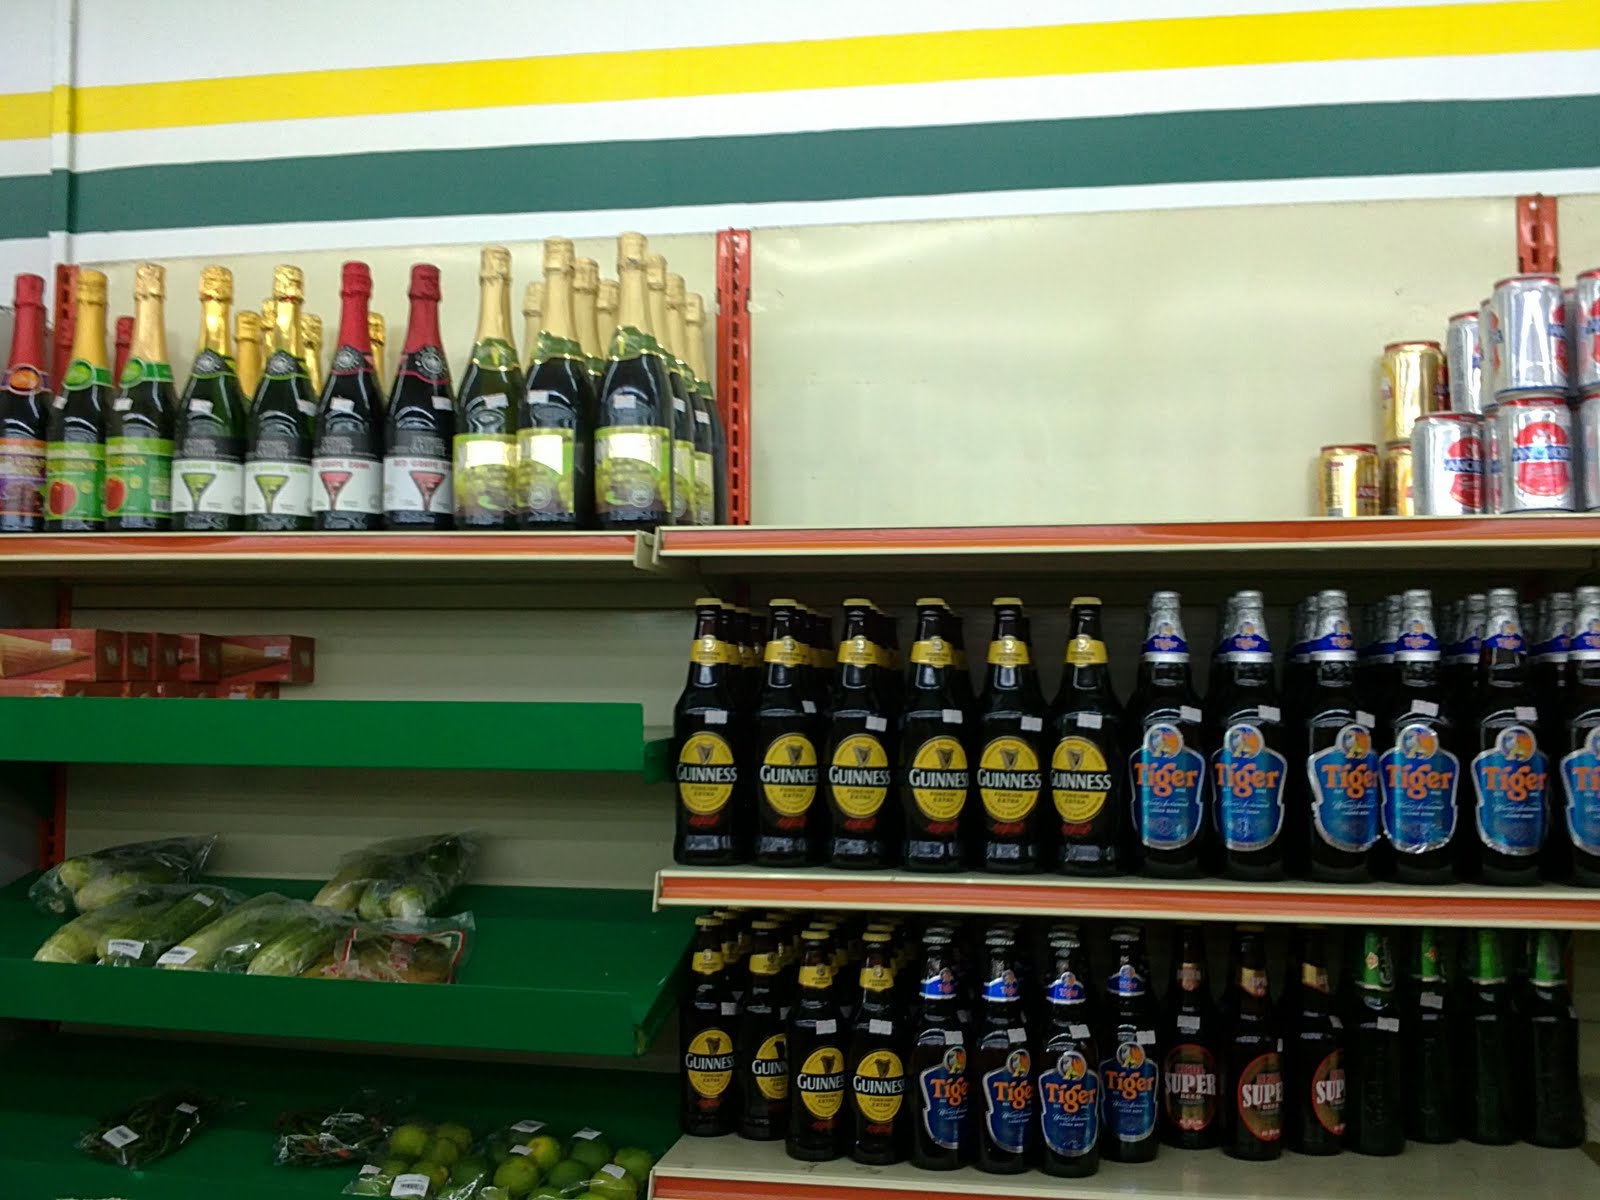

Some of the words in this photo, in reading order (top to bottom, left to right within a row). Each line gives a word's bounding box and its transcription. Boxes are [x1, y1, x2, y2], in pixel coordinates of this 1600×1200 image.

[676, 764, 738, 783] GUINNESS
[828, 766, 892, 786] GUINNESS
[977, 769, 1043, 790] GUINNESS
[1134, 762, 1198, 798] Tiger
[1215, 763, 1279, 798] Tiger
[1385, 764, 1453, 800] Tiger
[1481, 765, 1549, 802] Tiger
[930, 1076, 970, 1107] Tige
[993, 1079, 1034, 1111] Tige
[1045, 1083, 1097, 1114] Tiger
[1105, 1070, 1155, 1101] Tiger
[1164, 1072, 1217, 1096] SUPER
[1242, 1081, 1284, 1108] SUPE
[1316, 1079, 1345, 1105] SUP
